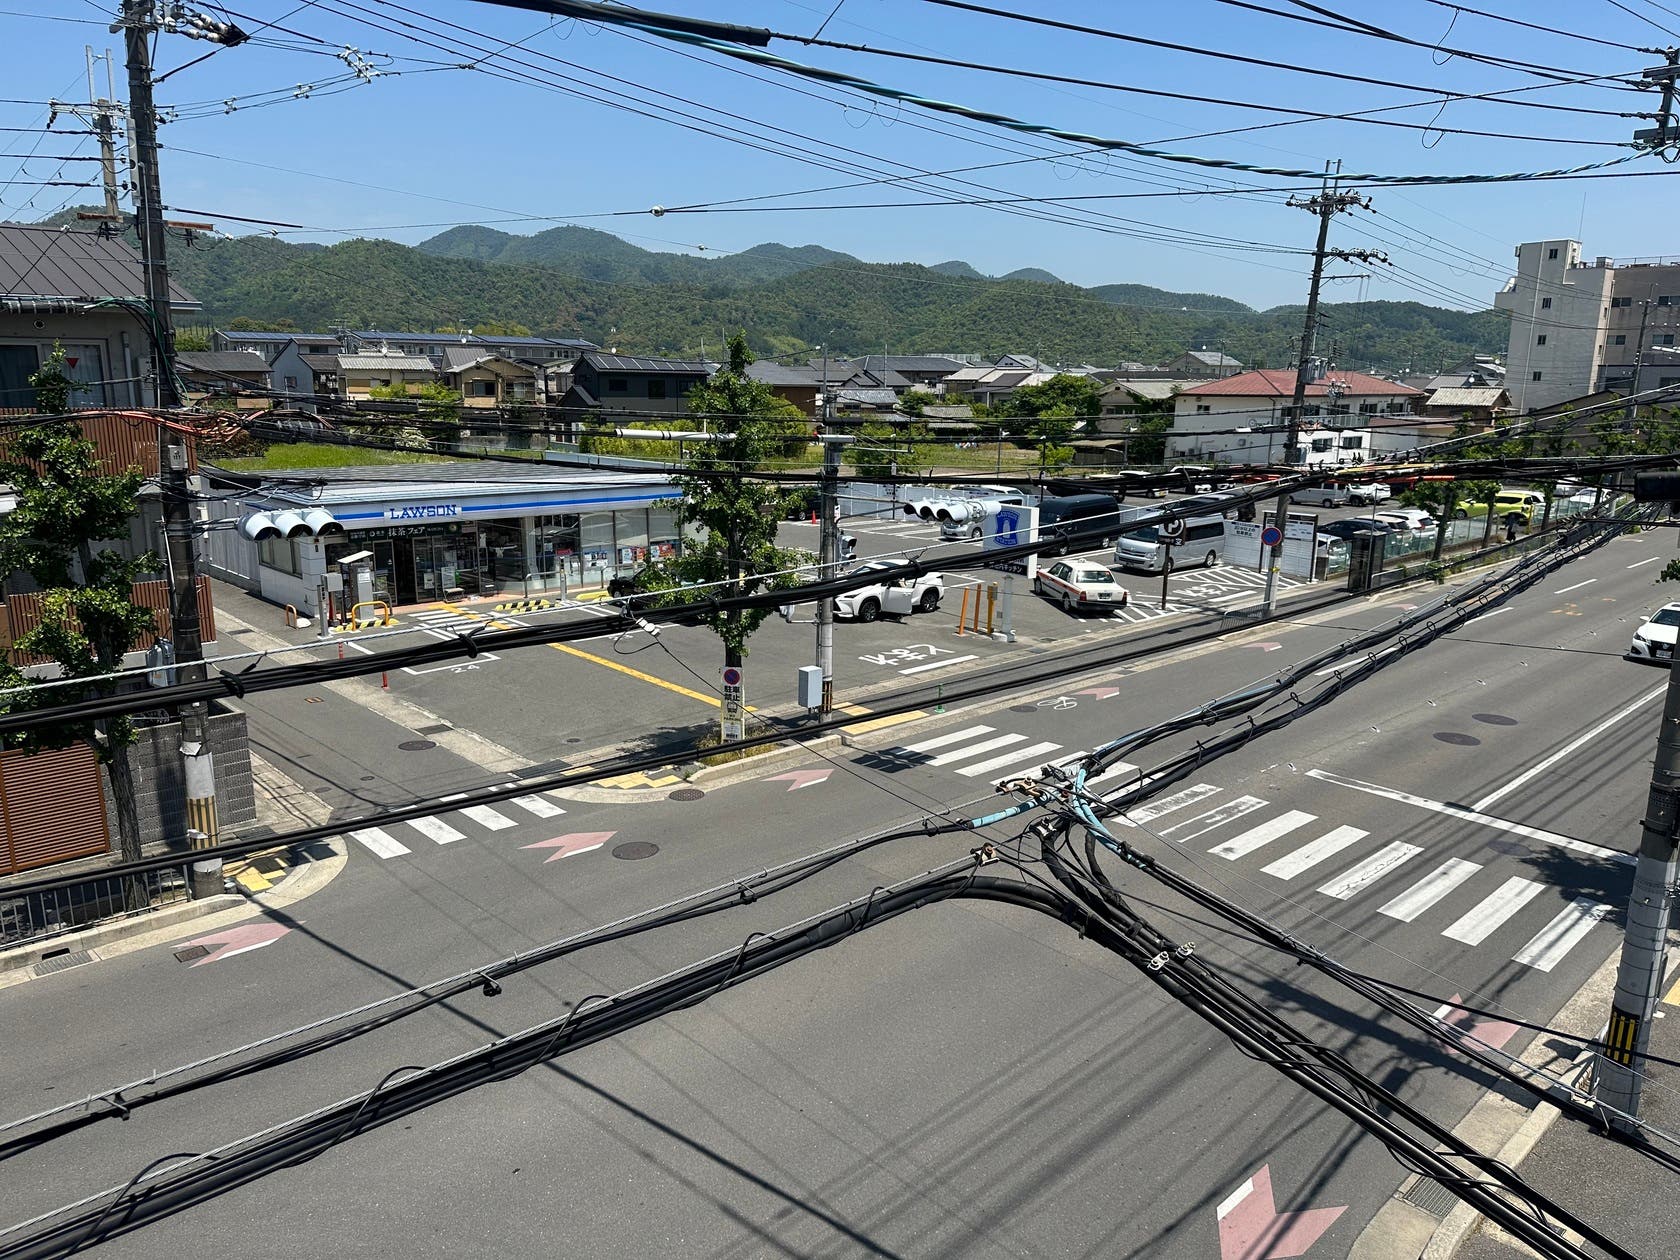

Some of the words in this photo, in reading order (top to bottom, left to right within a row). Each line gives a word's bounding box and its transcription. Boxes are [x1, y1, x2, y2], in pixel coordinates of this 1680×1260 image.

[389, 504, 457, 519] LAWSON
[388, 526, 426, 537] 抹茶フェア
[858, 643, 956, 666] とまれ
